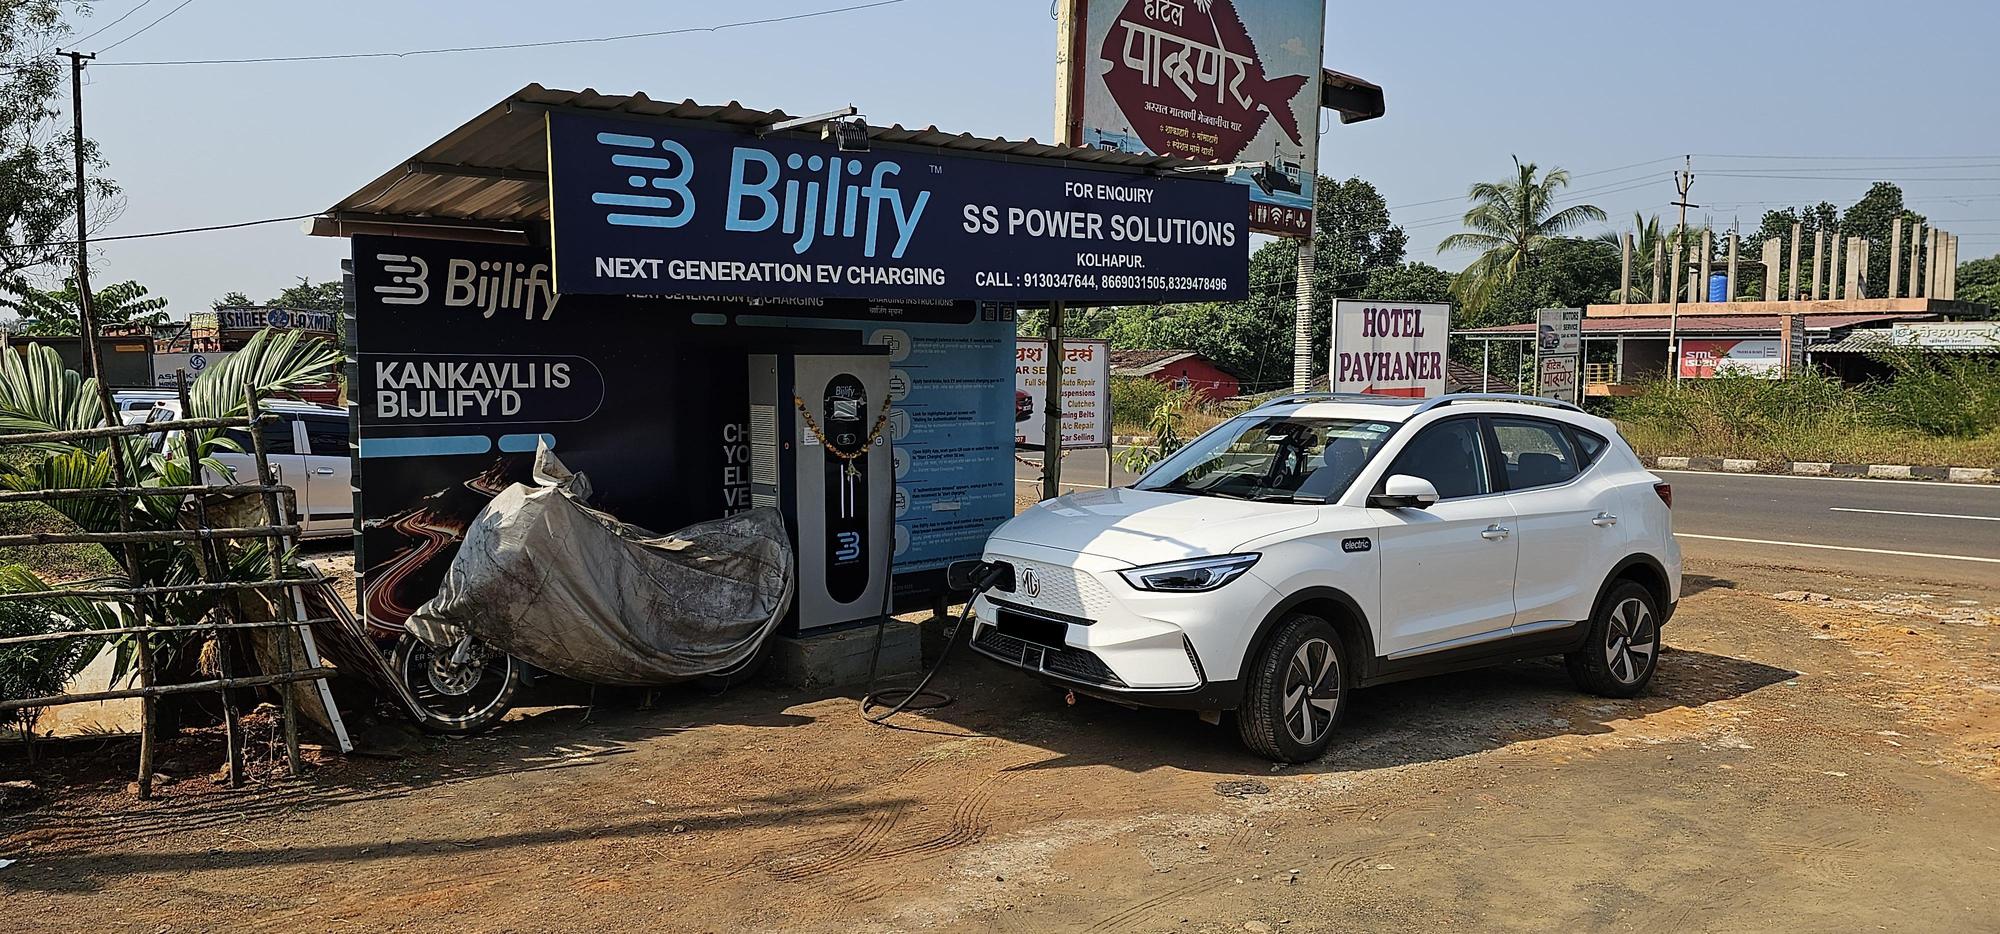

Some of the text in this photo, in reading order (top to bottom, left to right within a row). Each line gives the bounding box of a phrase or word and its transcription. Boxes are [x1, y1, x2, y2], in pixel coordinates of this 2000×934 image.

[1065, 181, 1154, 203] FOR ENQUIRY
[725, 147, 931, 259] Bijlify
[963, 204, 1236, 247] SS POWER SOLUTIONS
[1077, 253, 1145, 268] KOLHAPUR.
[595, 257, 945, 285] NEXT GENERATION EV CHARGING
[975, 271, 1013, 287] CALL
[1024, 272, 1098, 290] 9130347644,
[445, 258, 561, 320] Bijlify
[1363, 308, 1424, 337] HOTEL
[1016, 366, 1029, 374] AR
[1339, 352, 1442, 382] PAVHANER
[1685, 359, 1717, 367] ISUZU
[375, 362, 570, 389] KANKAVLI IS
[1076, 379, 1096, 388] Repair
[1061, 389, 1096, 398] uspensions
[377, 389, 521, 418] BIJLIFY’D
[1068, 400, 1095, 408] Clutches
[1061, 411, 1078, 419] ming
[1074, 422, 1094, 431] Repair
[1073, 433, 1095, 442] Selling
[1344, 539, 1369, 550] electric
[1022, 567, 1040, 598] MG
